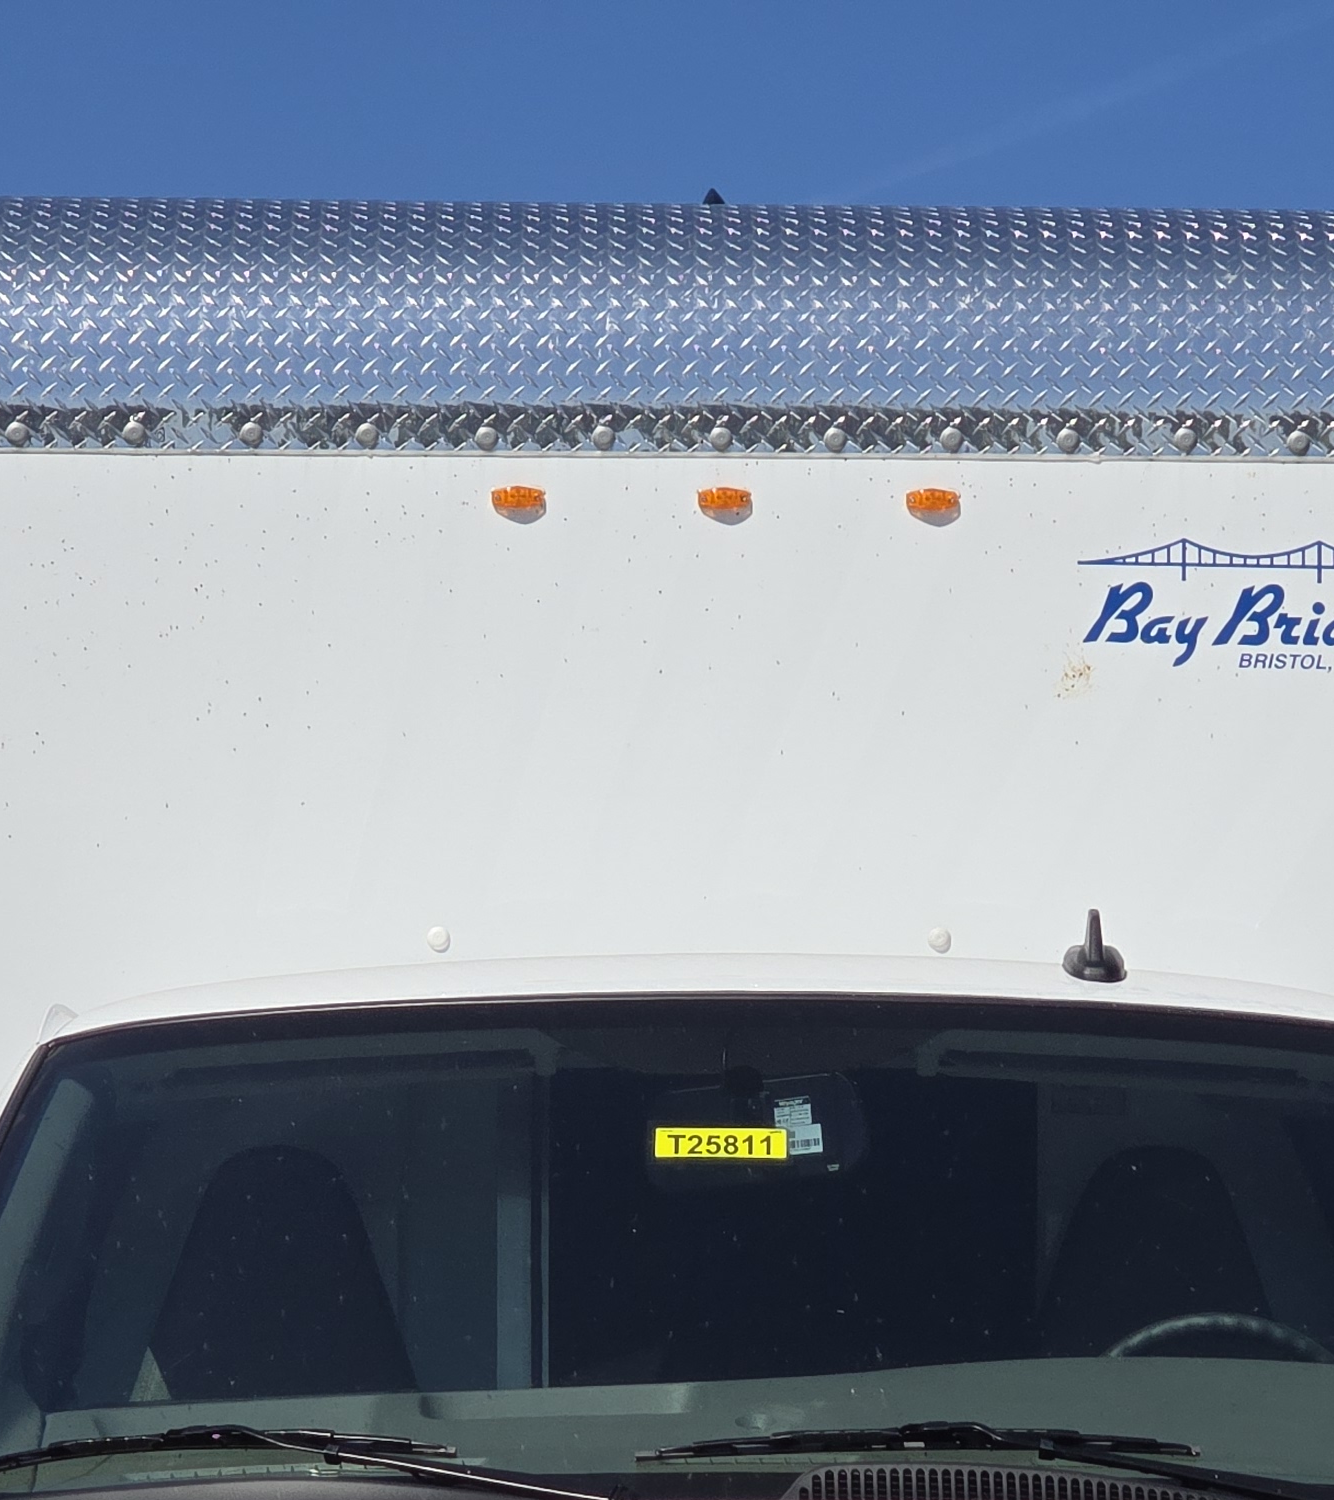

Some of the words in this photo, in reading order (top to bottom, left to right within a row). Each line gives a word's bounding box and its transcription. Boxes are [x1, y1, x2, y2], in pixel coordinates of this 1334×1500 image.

[1082, 581, 1209, 667] Bay
[1238, 653, 1333, 673] BRISTOL,
[667, 1134, 772, 1155] T25811
